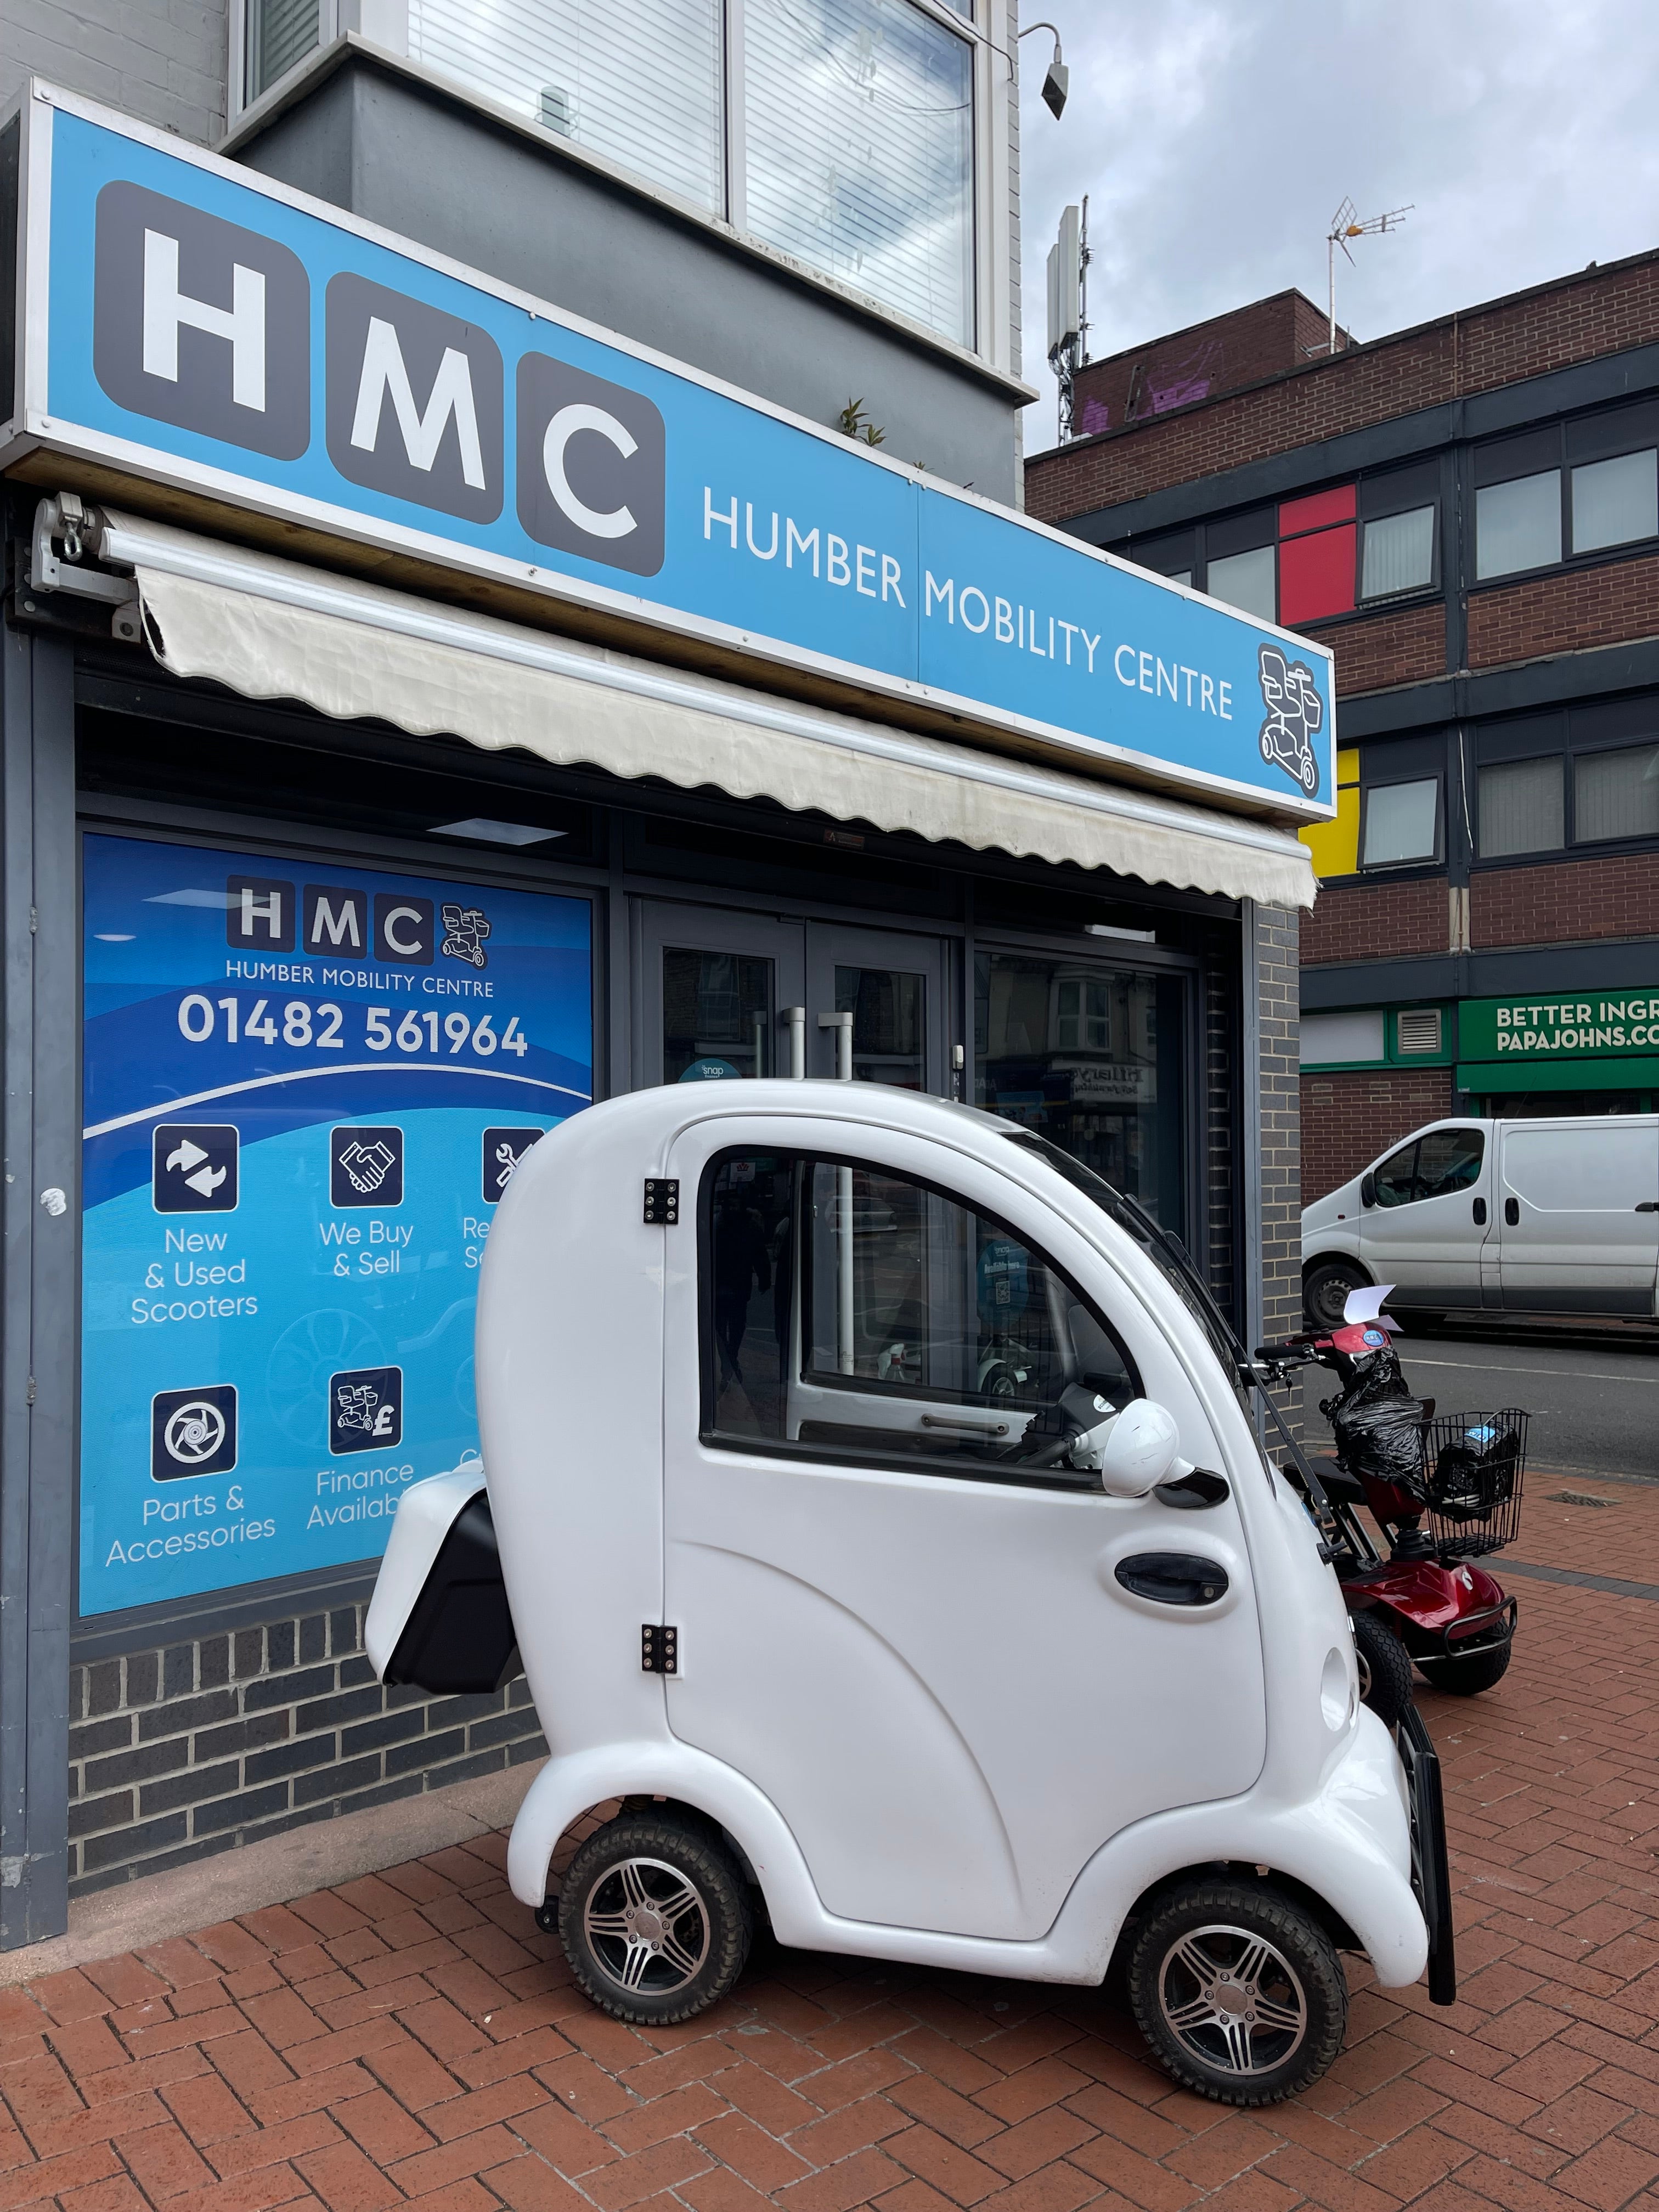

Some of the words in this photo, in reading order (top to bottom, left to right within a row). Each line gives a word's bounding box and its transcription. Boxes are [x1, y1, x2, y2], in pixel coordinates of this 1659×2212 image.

[703, 487, 906, 608] HUMBER
[926, 571, 1101, 673] MOBILITY
[1115, 645, 1233, 720] CENTRE
[226, 960, 314, 984] HUMBER
[323, 969, 415, 991] MOBILITY
[422, 978, 493, 998] CENTRE
[178, 994, 344, 1048] 01482
[365, 1007, 528, 1057] 561964
[1497, 1004, 1592, 1027] BETTER
[1600, 1000, 1659, 1023] INGR
[702, 1066, 724, 1077] snap
[165, 1229, 228, 1254] New
[319, 1223, 362, 1246] We
[370, 1220, 414, 1249] Buy
[145, 1263, 165, 1289] &
[175, 1259, 246, 1286] Used
[334, 1254, 351, 1277] &
[359, 1250, 400, 1274] Sell
[131, 1295, 258, 1324] Scooters
[317, 1464, 414, 1496] Finance
[143, 1493, 216, 1526] Parts
[225, 1485, 245, 1510] &
[307, 1489, 405, 1530] Availab
[106, 1517, 275, 1567] Accessories
